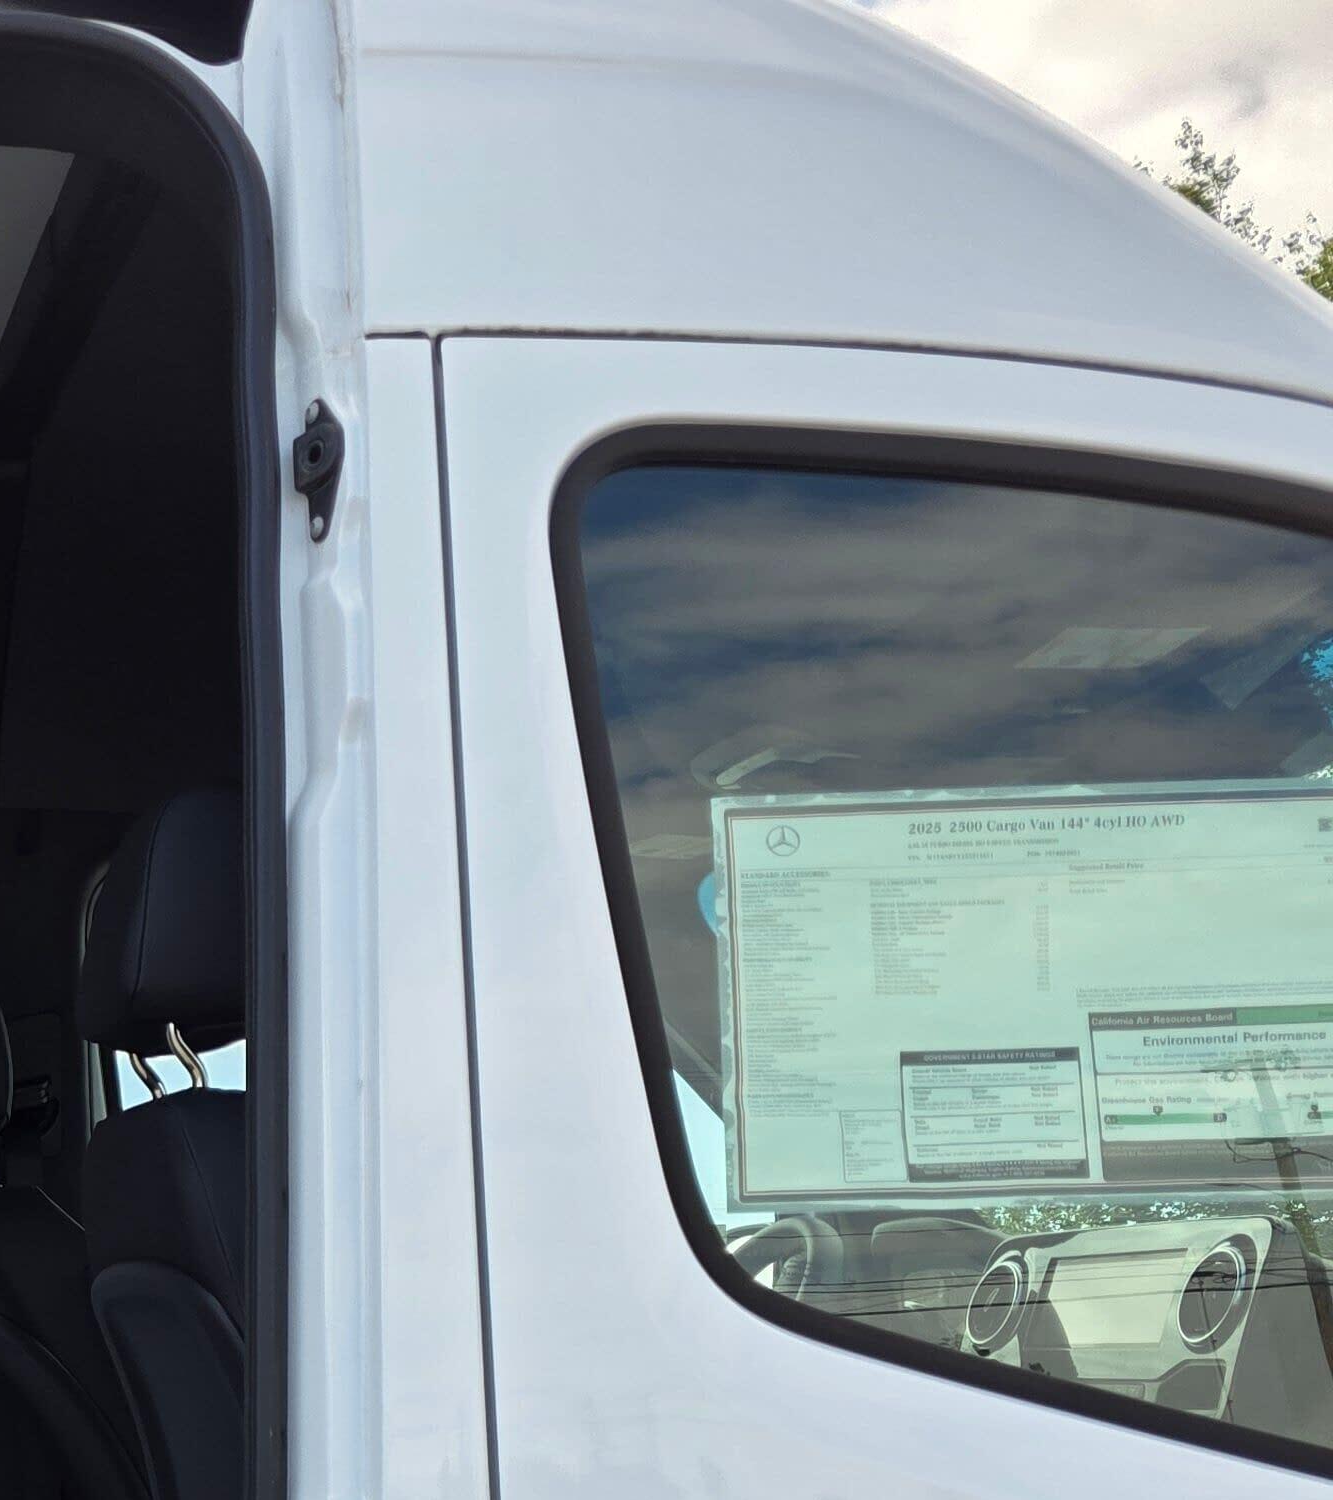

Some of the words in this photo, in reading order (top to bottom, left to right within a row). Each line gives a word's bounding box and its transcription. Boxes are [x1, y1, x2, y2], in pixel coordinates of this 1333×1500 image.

[908, 822, 942, 835] 2025
[950, 820, 983, 833] 2500
[986, 820, 1025, 833] Cargo
[1030, 819, 1055, 831] Van
[1094, 816, 1122, 831] 4cyl
[1126, 815, 1147, 828] HO
[1150, 814, 1185, 828] AWD
[1091, 1016, 1134, 1026] California
[1136, 1016, 1150, 1025] Air
[1153, 1015, 1202, 1025] Resources
[1205, 1012, 1233, 1022] Board
[1142, 1032, 1238, 1047] Environmental
[1243, 1031, 1327, 1043] Performance
